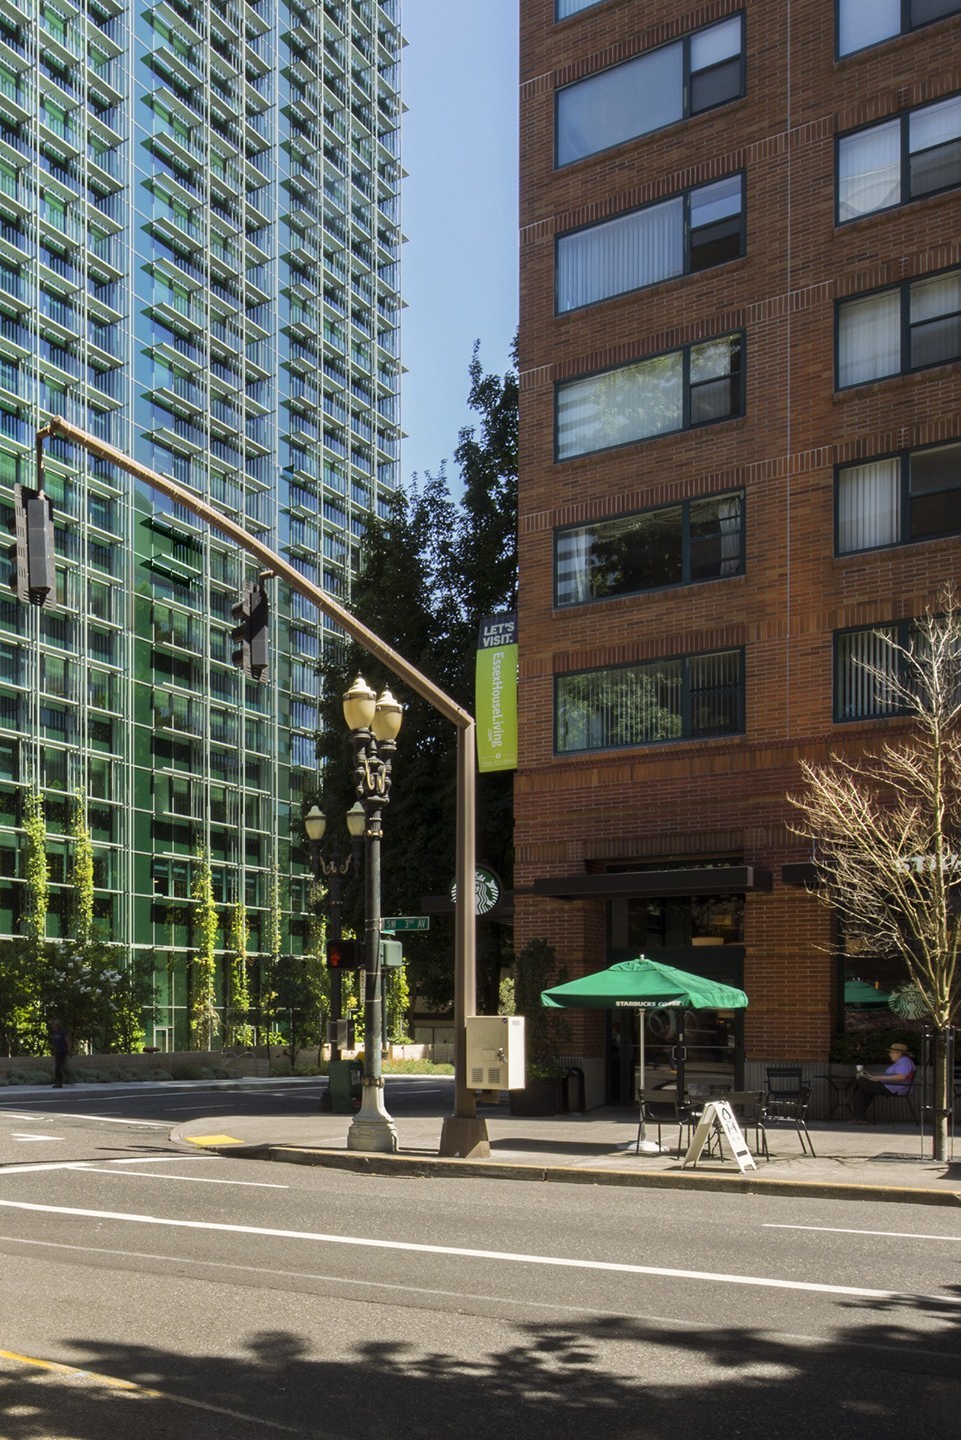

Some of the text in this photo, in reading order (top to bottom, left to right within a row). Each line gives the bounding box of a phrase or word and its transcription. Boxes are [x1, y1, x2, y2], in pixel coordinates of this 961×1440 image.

[483, 621, 515, 637] LET'S
[482, 633, 514, 648] VISIT.
[491, 651, 504, 748] EssexHouseLiving
[386, 920, 397, 929] SW
[417, 919, 426, 928] AV
